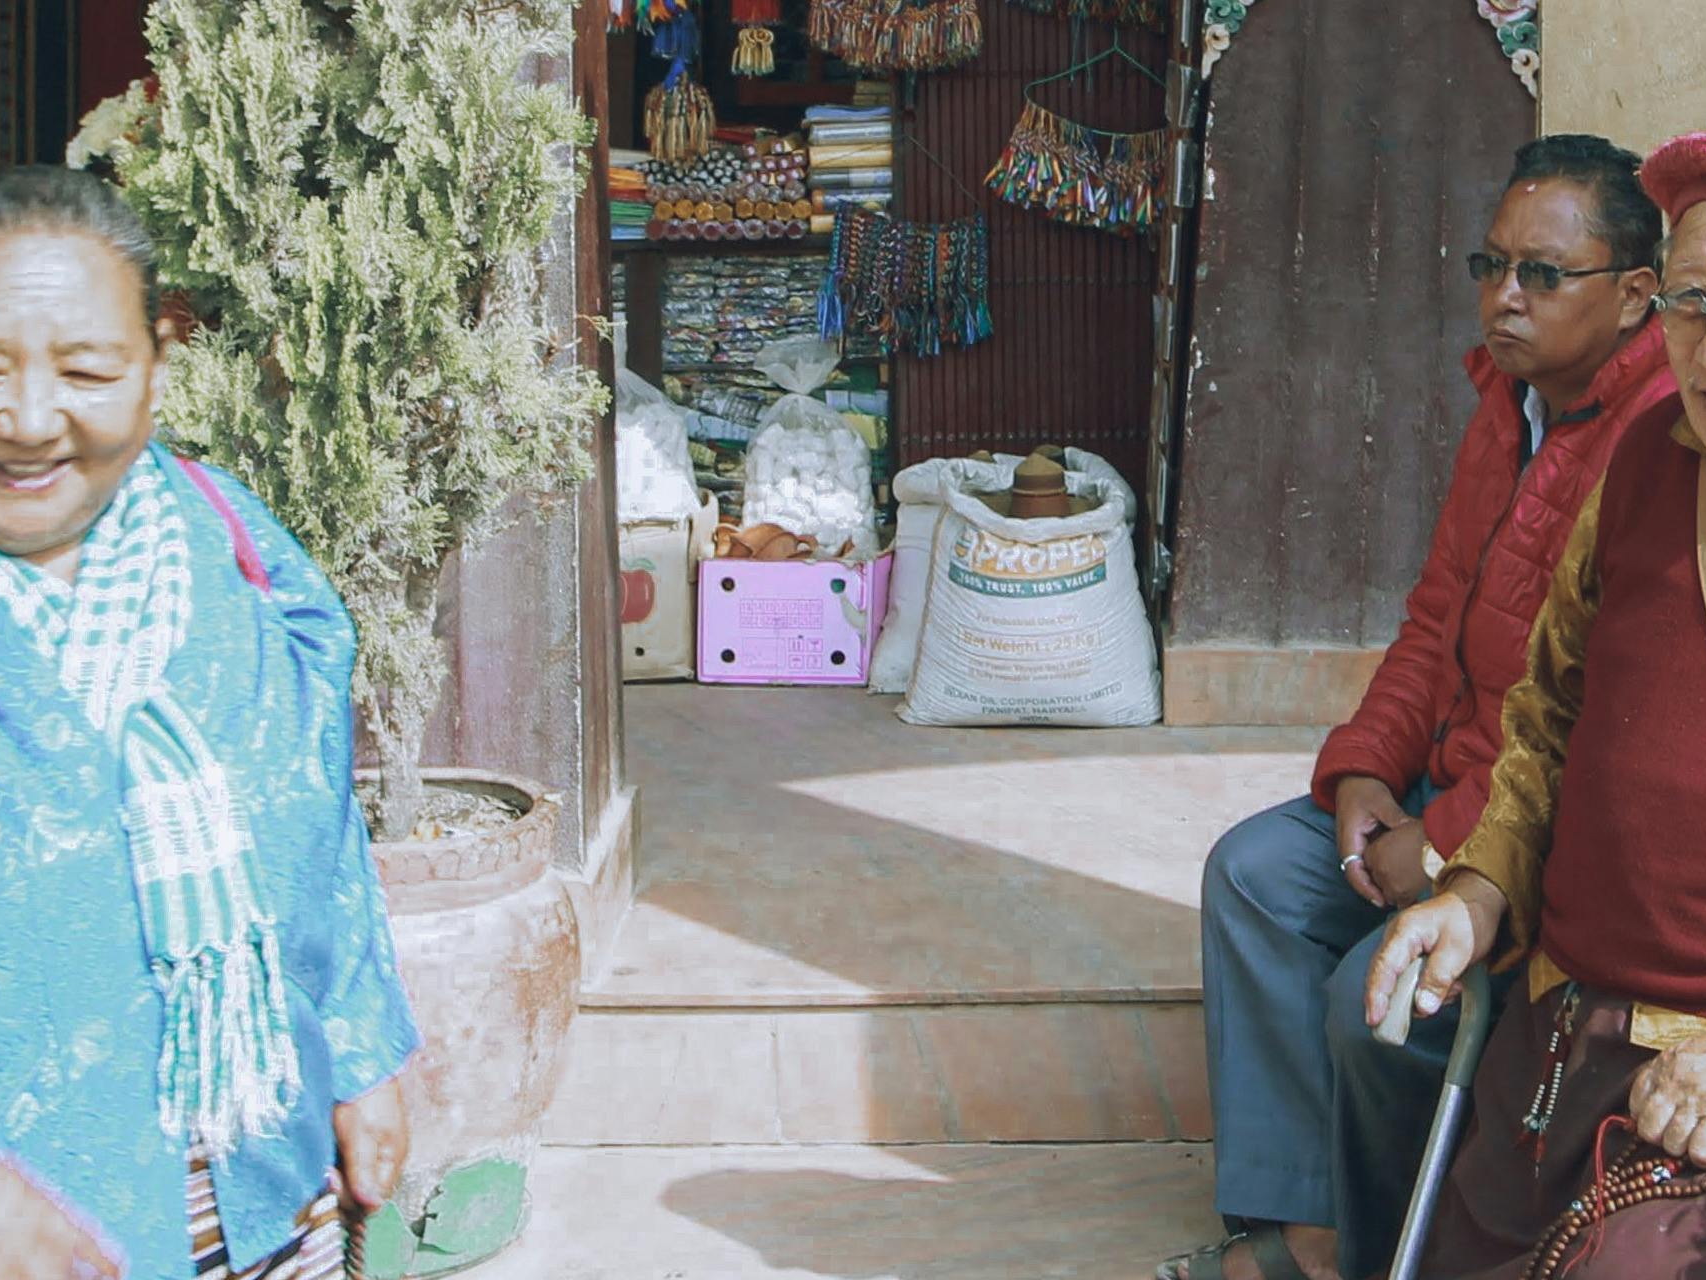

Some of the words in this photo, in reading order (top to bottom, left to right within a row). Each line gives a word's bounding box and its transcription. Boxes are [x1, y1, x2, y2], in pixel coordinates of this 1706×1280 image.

[1033, 581, 1062, 594] 100%
[989, 639, 1039, 652] Weight
[1000, 695, 1082, 706] CORPORATION
[1084, 682, 1123, 702] LIMITED
